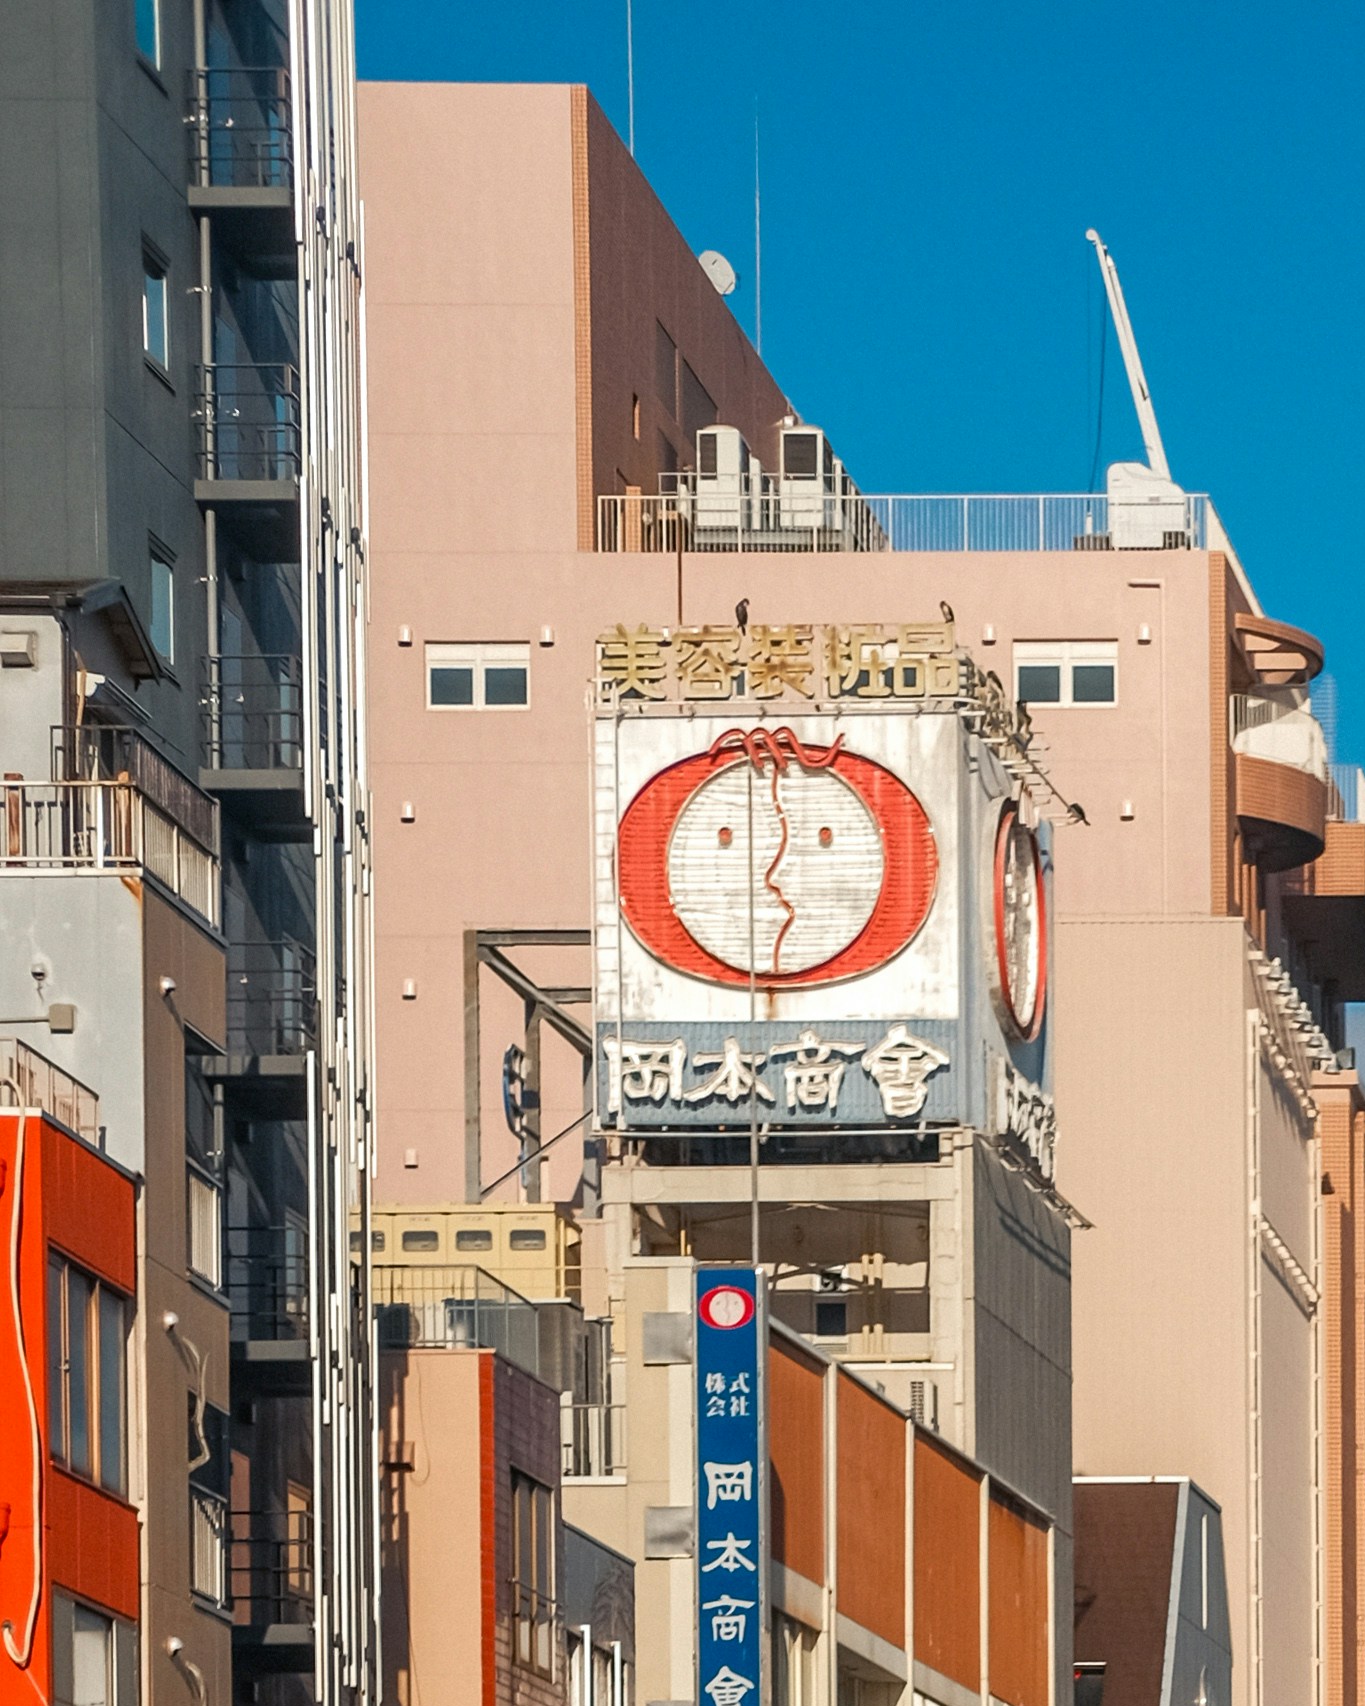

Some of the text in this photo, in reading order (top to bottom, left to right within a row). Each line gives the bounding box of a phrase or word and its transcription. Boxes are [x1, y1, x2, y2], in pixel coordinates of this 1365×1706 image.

[598, 623, 960, 701] 美容装粧品
[602, 1024, 950, 1119] 岡本商會
